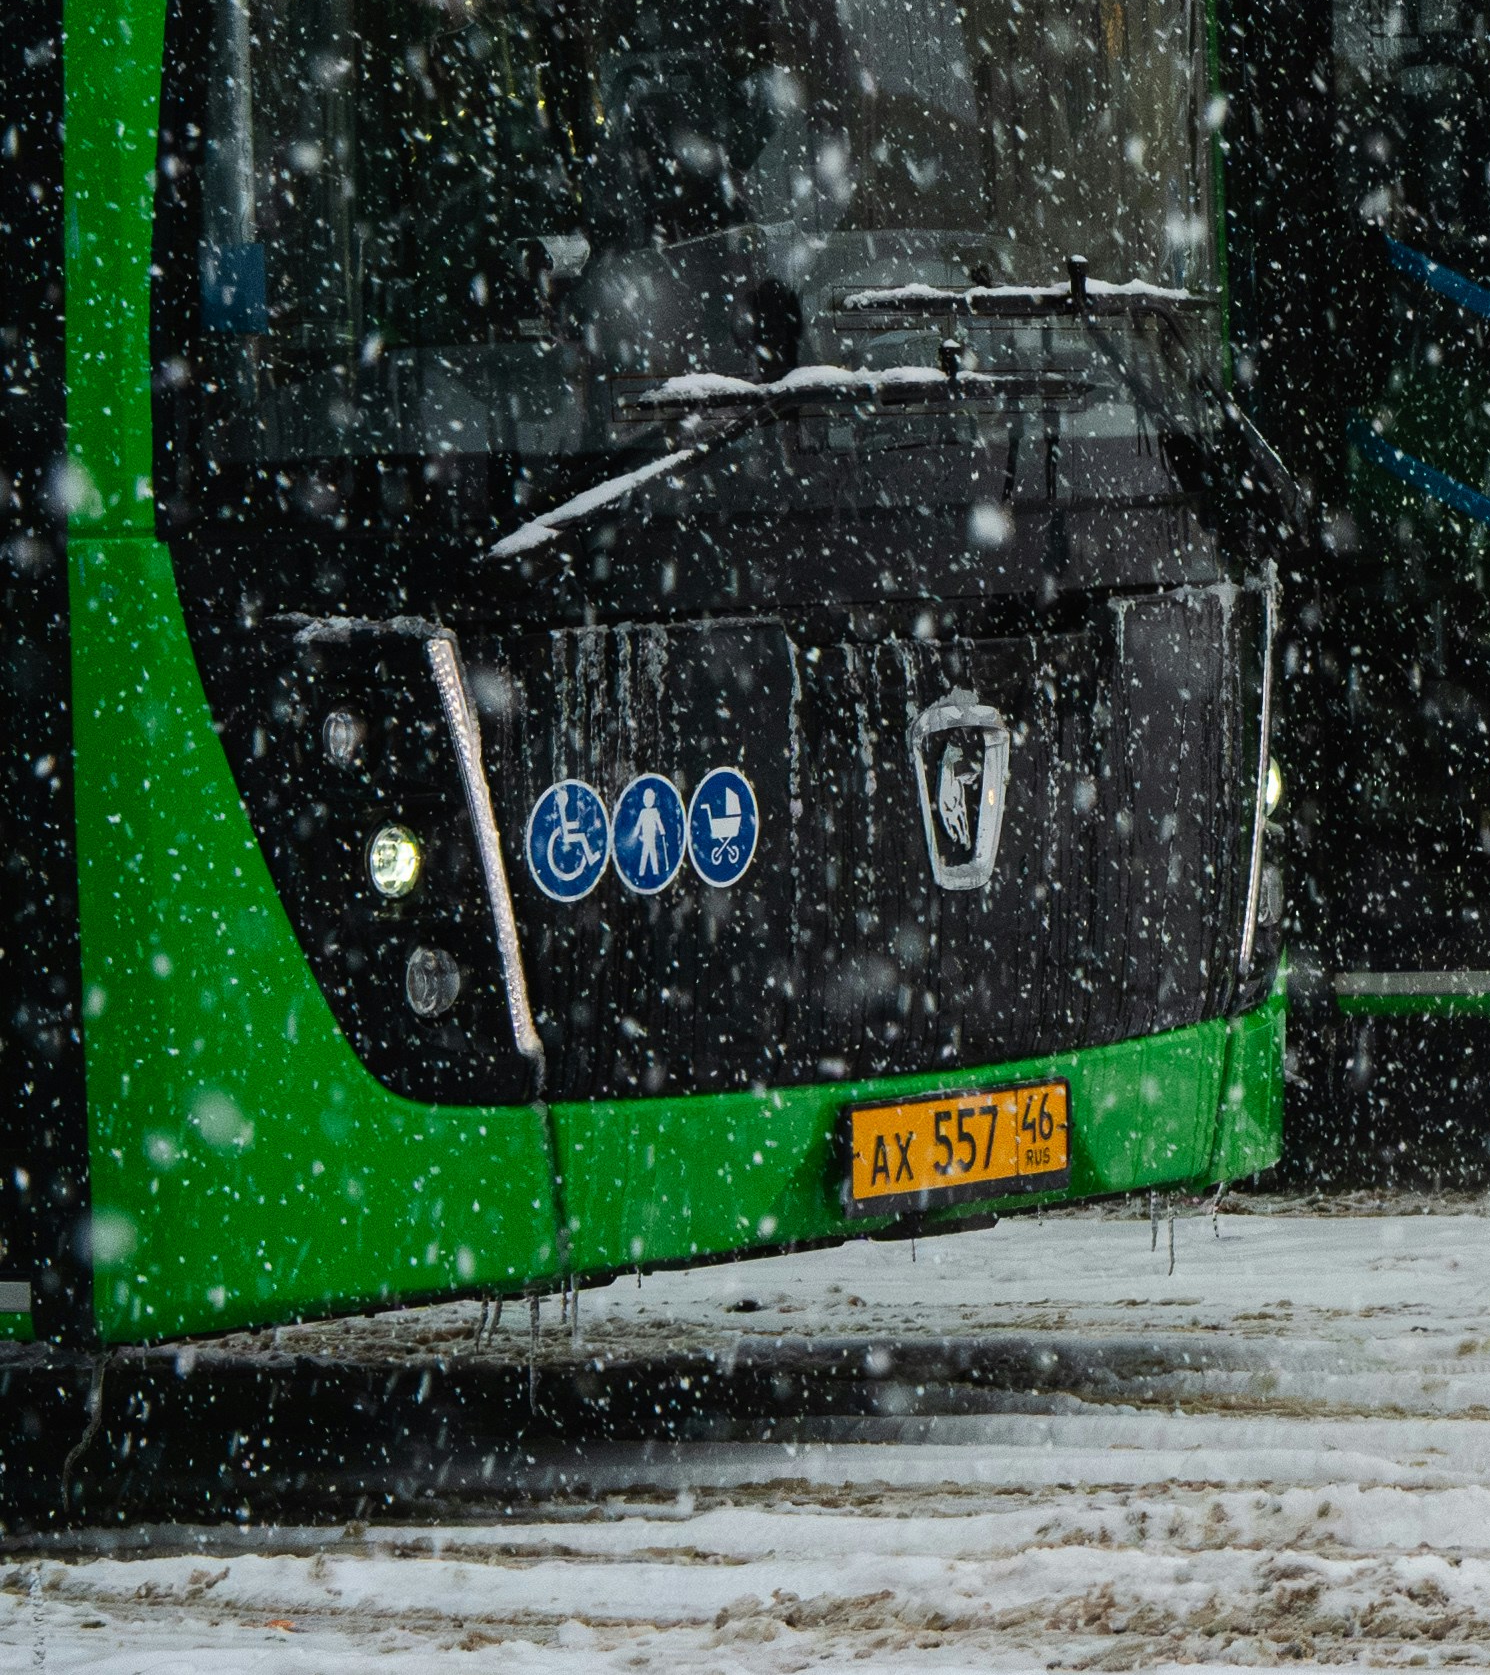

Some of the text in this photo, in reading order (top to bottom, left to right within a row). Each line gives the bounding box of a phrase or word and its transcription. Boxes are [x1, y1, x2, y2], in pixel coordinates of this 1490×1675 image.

[932, 1104, 999, 1176] 557
[1021, 1092, 1055, 1144] 46
[1025, 1148, 1051, 1167] RUS
